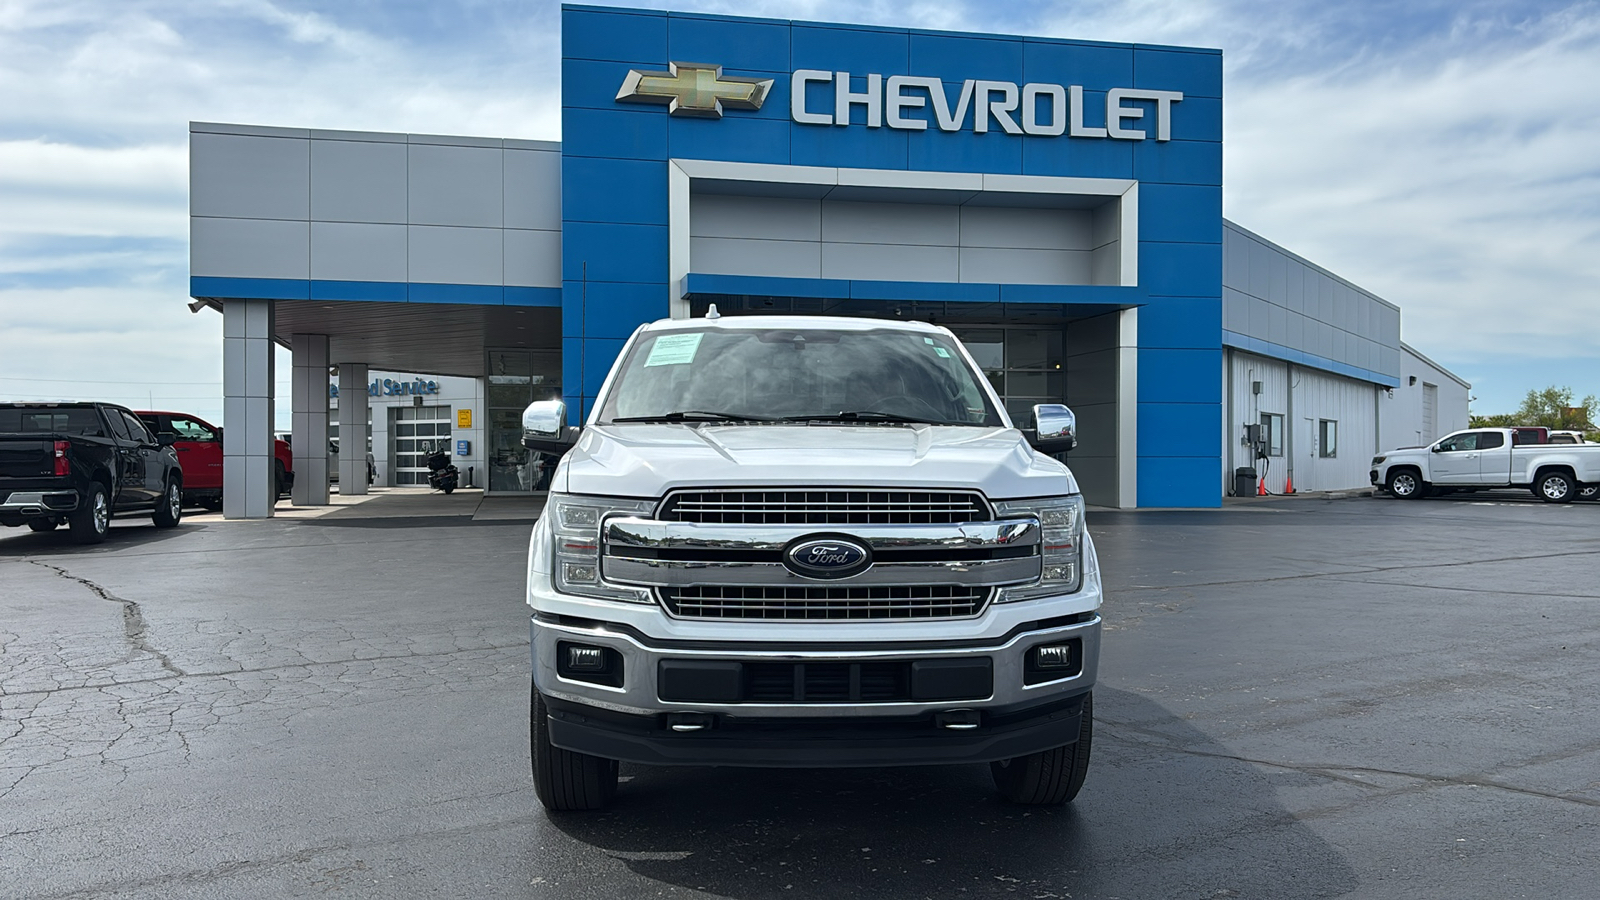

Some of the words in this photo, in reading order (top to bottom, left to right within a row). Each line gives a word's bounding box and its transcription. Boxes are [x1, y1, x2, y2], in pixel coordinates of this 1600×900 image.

[791, 69, 1183, 141] CHEVROLET
[383, 377, 437, 396] Service
[808, 546, 848, 564] Ford
